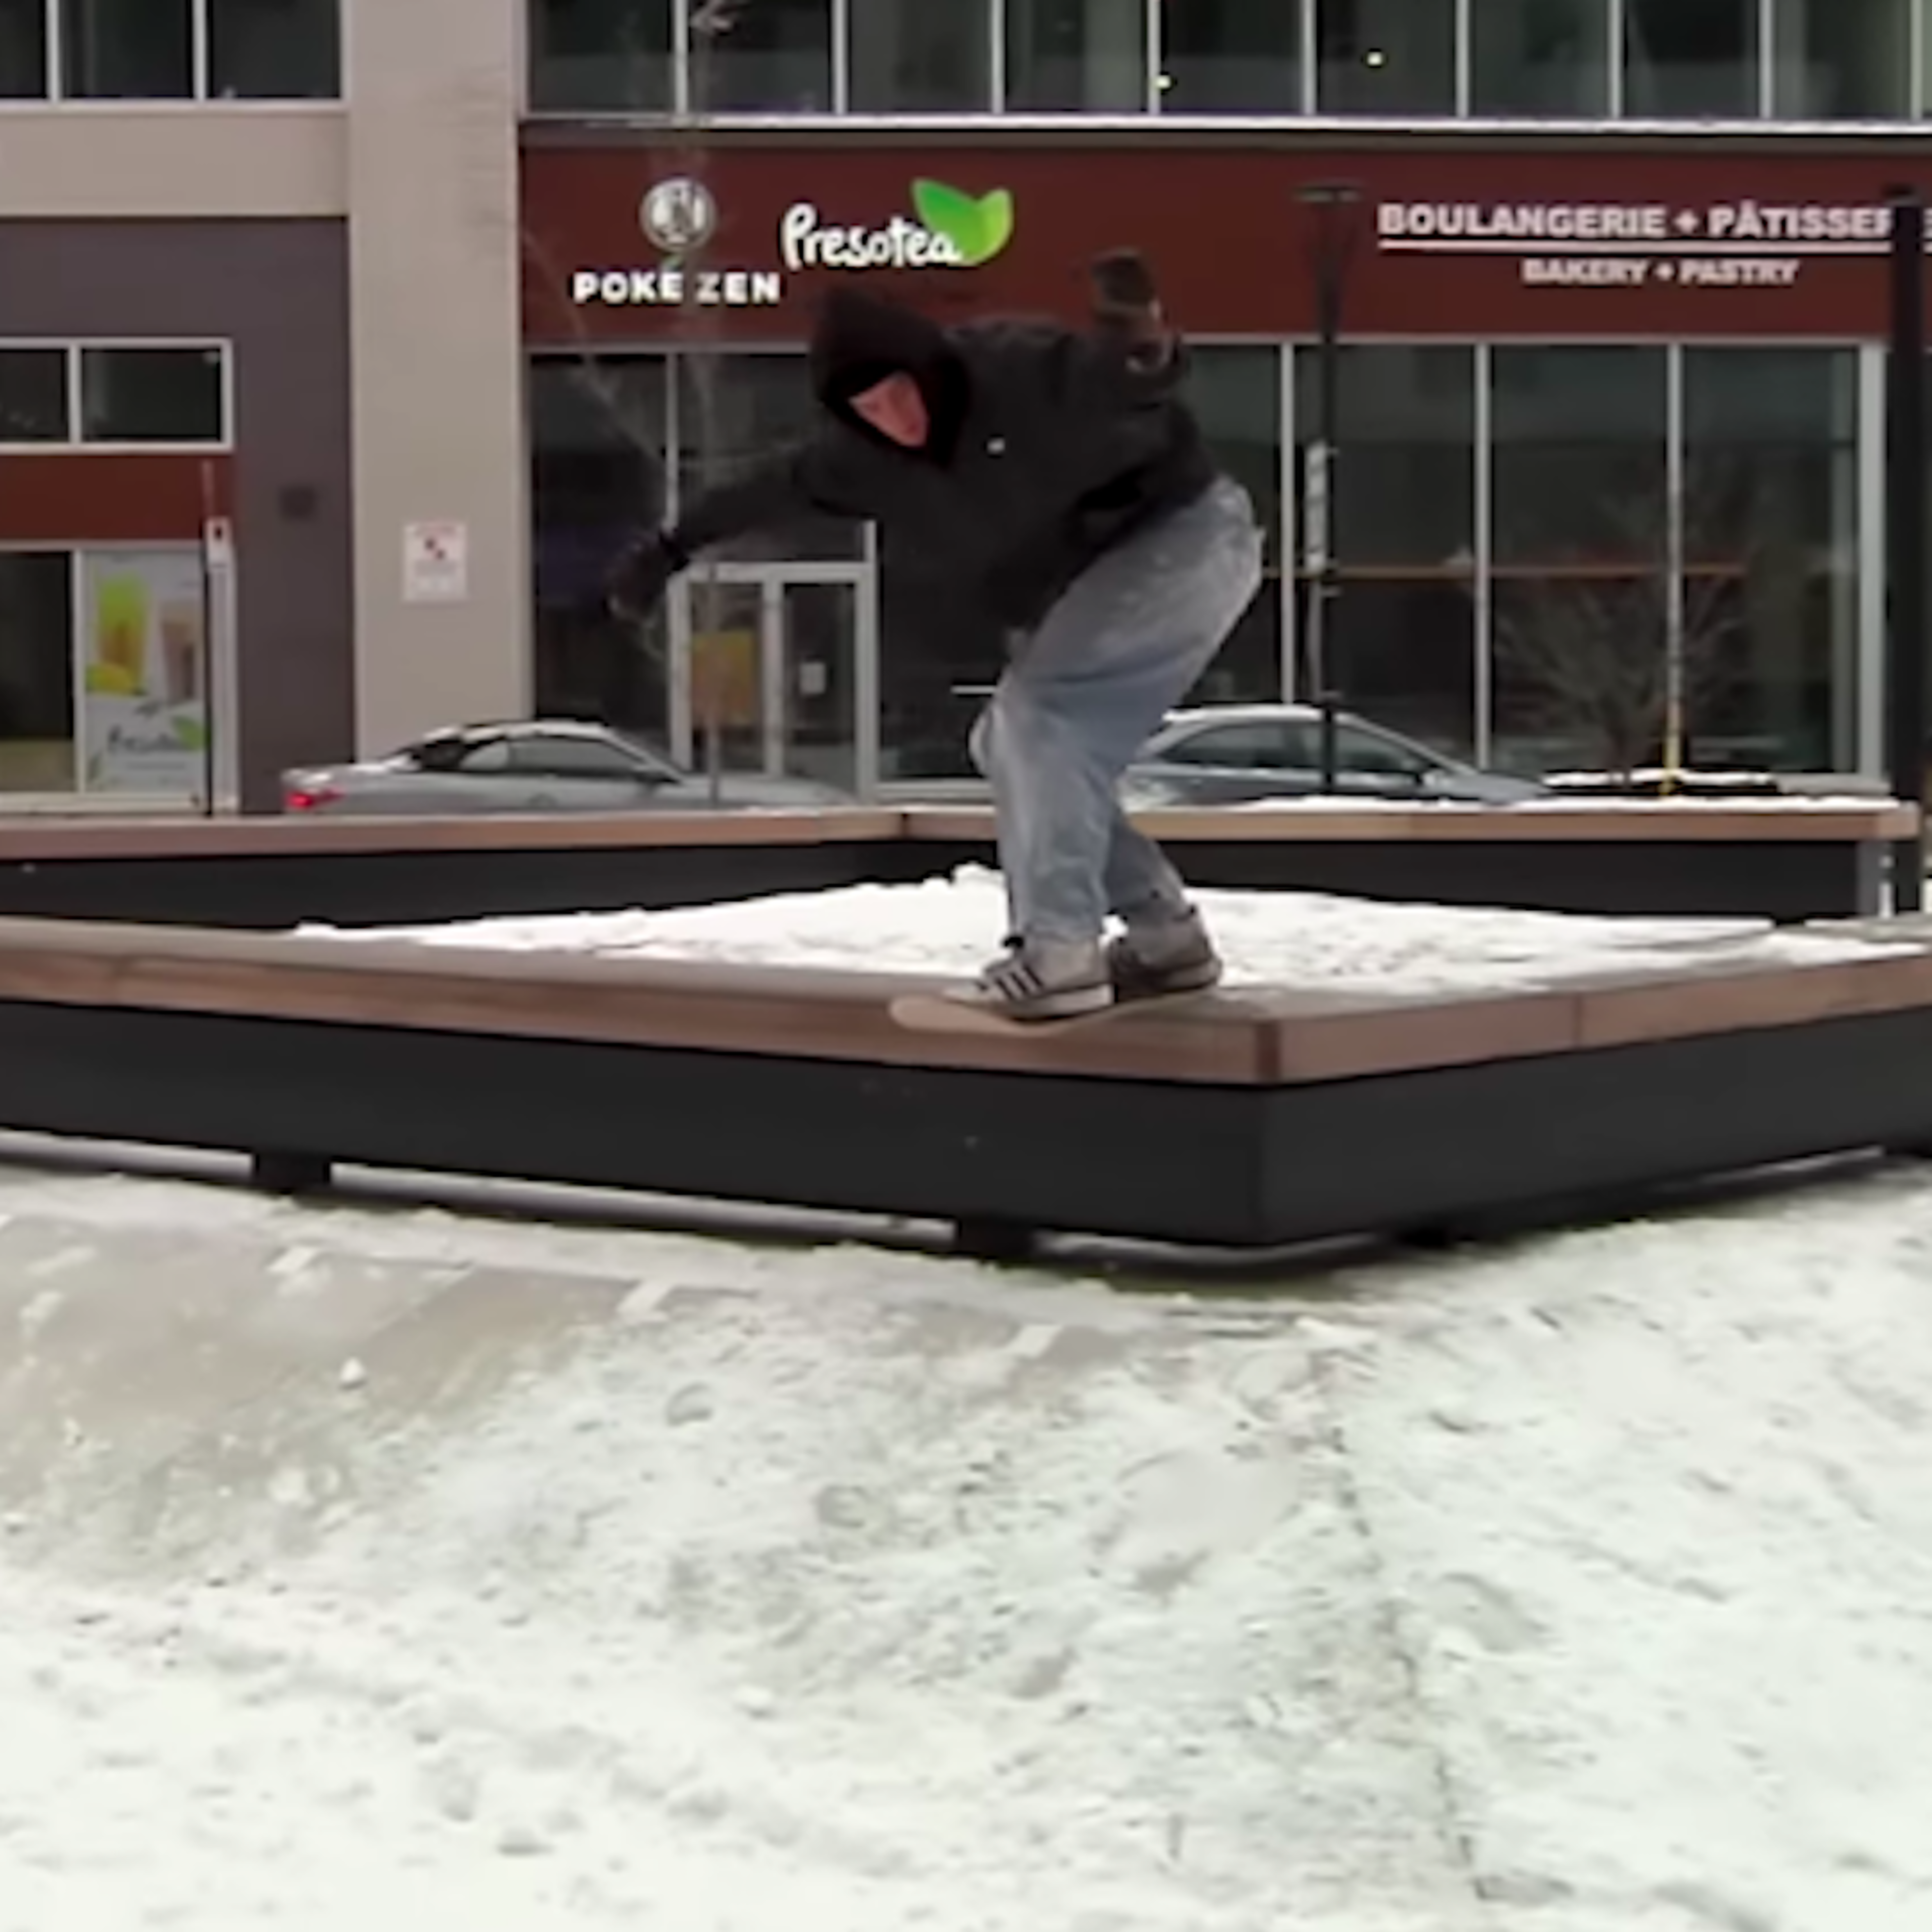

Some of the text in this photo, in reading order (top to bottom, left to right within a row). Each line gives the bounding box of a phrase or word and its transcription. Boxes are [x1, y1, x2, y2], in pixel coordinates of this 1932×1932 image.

[782, 203, 964, 270] Presotea
[1378, 203, 1667, 237] BOULANGERIE
[1522, 258, 1649, 284] BAKERY
[1679, 258, 1799, 284] PASTRY
[695, 272, 780, 304] ZEN
